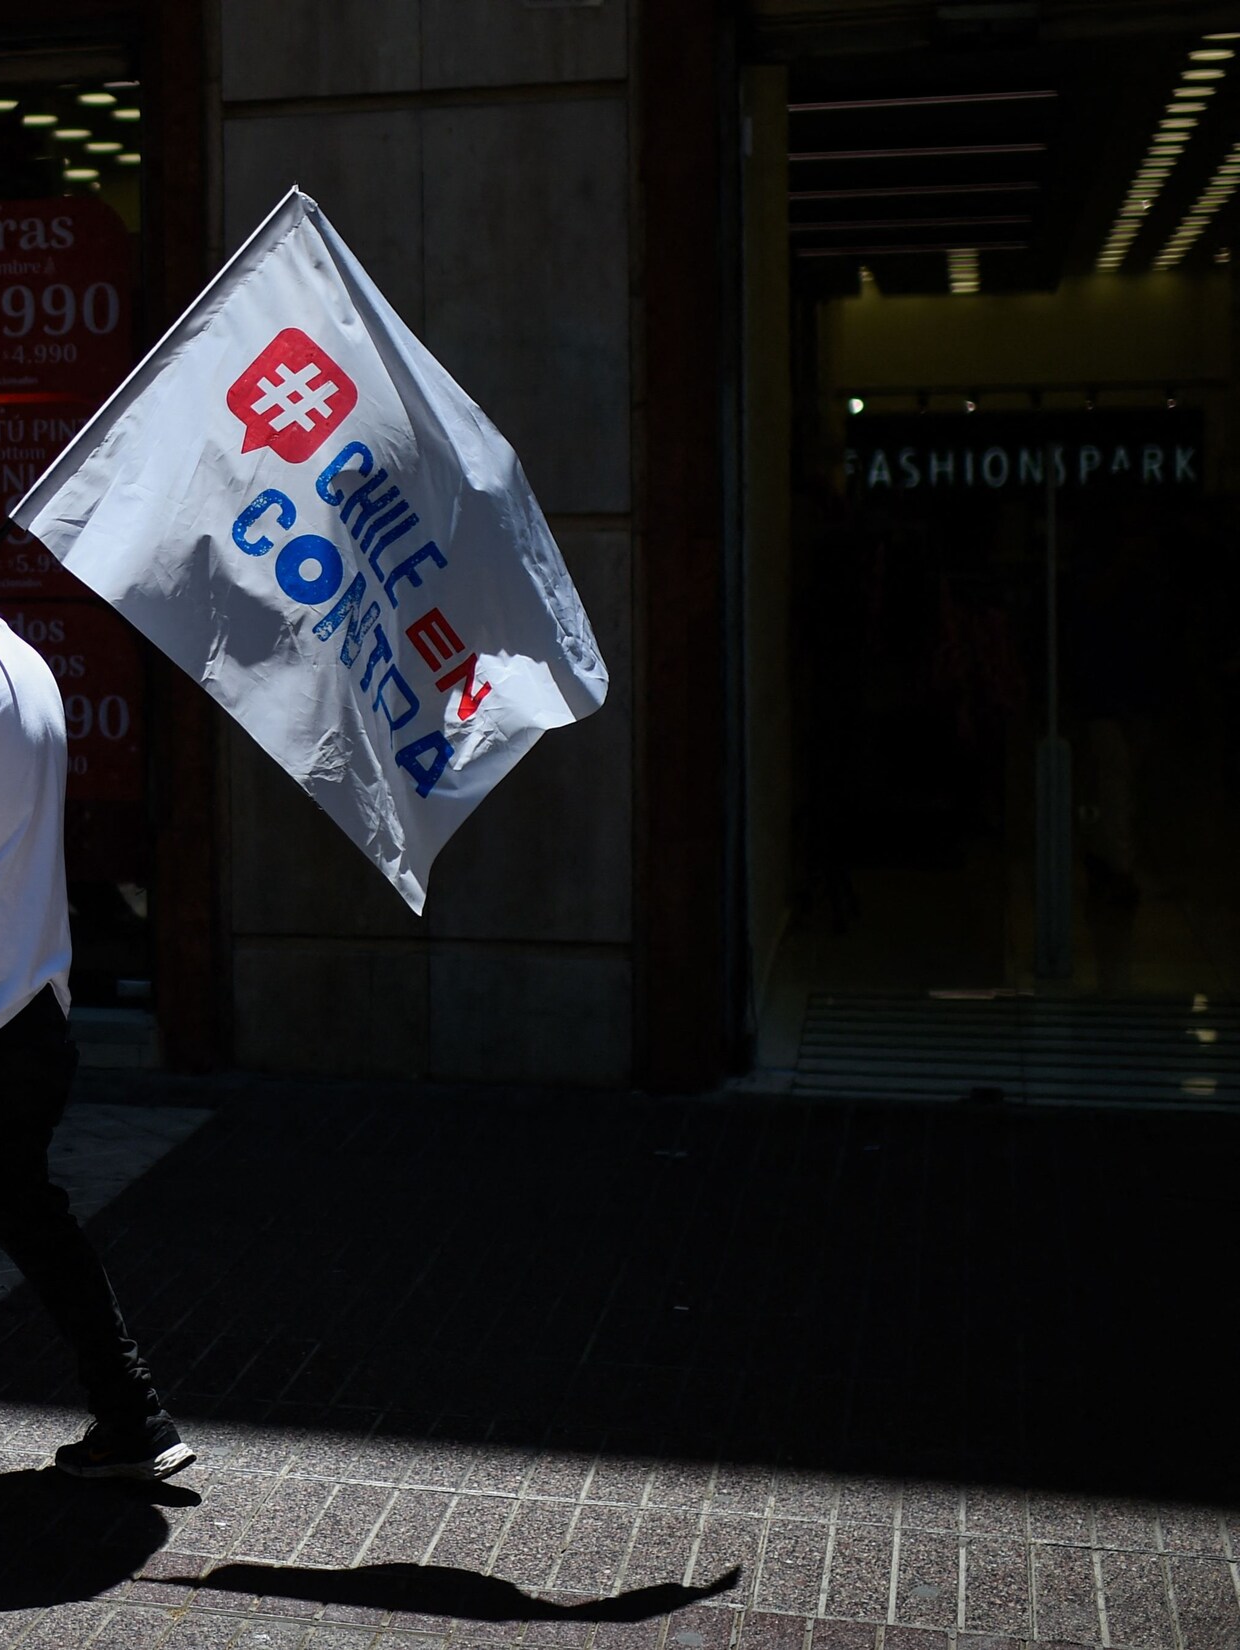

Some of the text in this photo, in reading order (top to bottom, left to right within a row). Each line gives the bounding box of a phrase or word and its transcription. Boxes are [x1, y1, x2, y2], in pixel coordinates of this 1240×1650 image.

[10, 612, 66, 643] dos
[316, 441, 491, 721] CHILE EN
